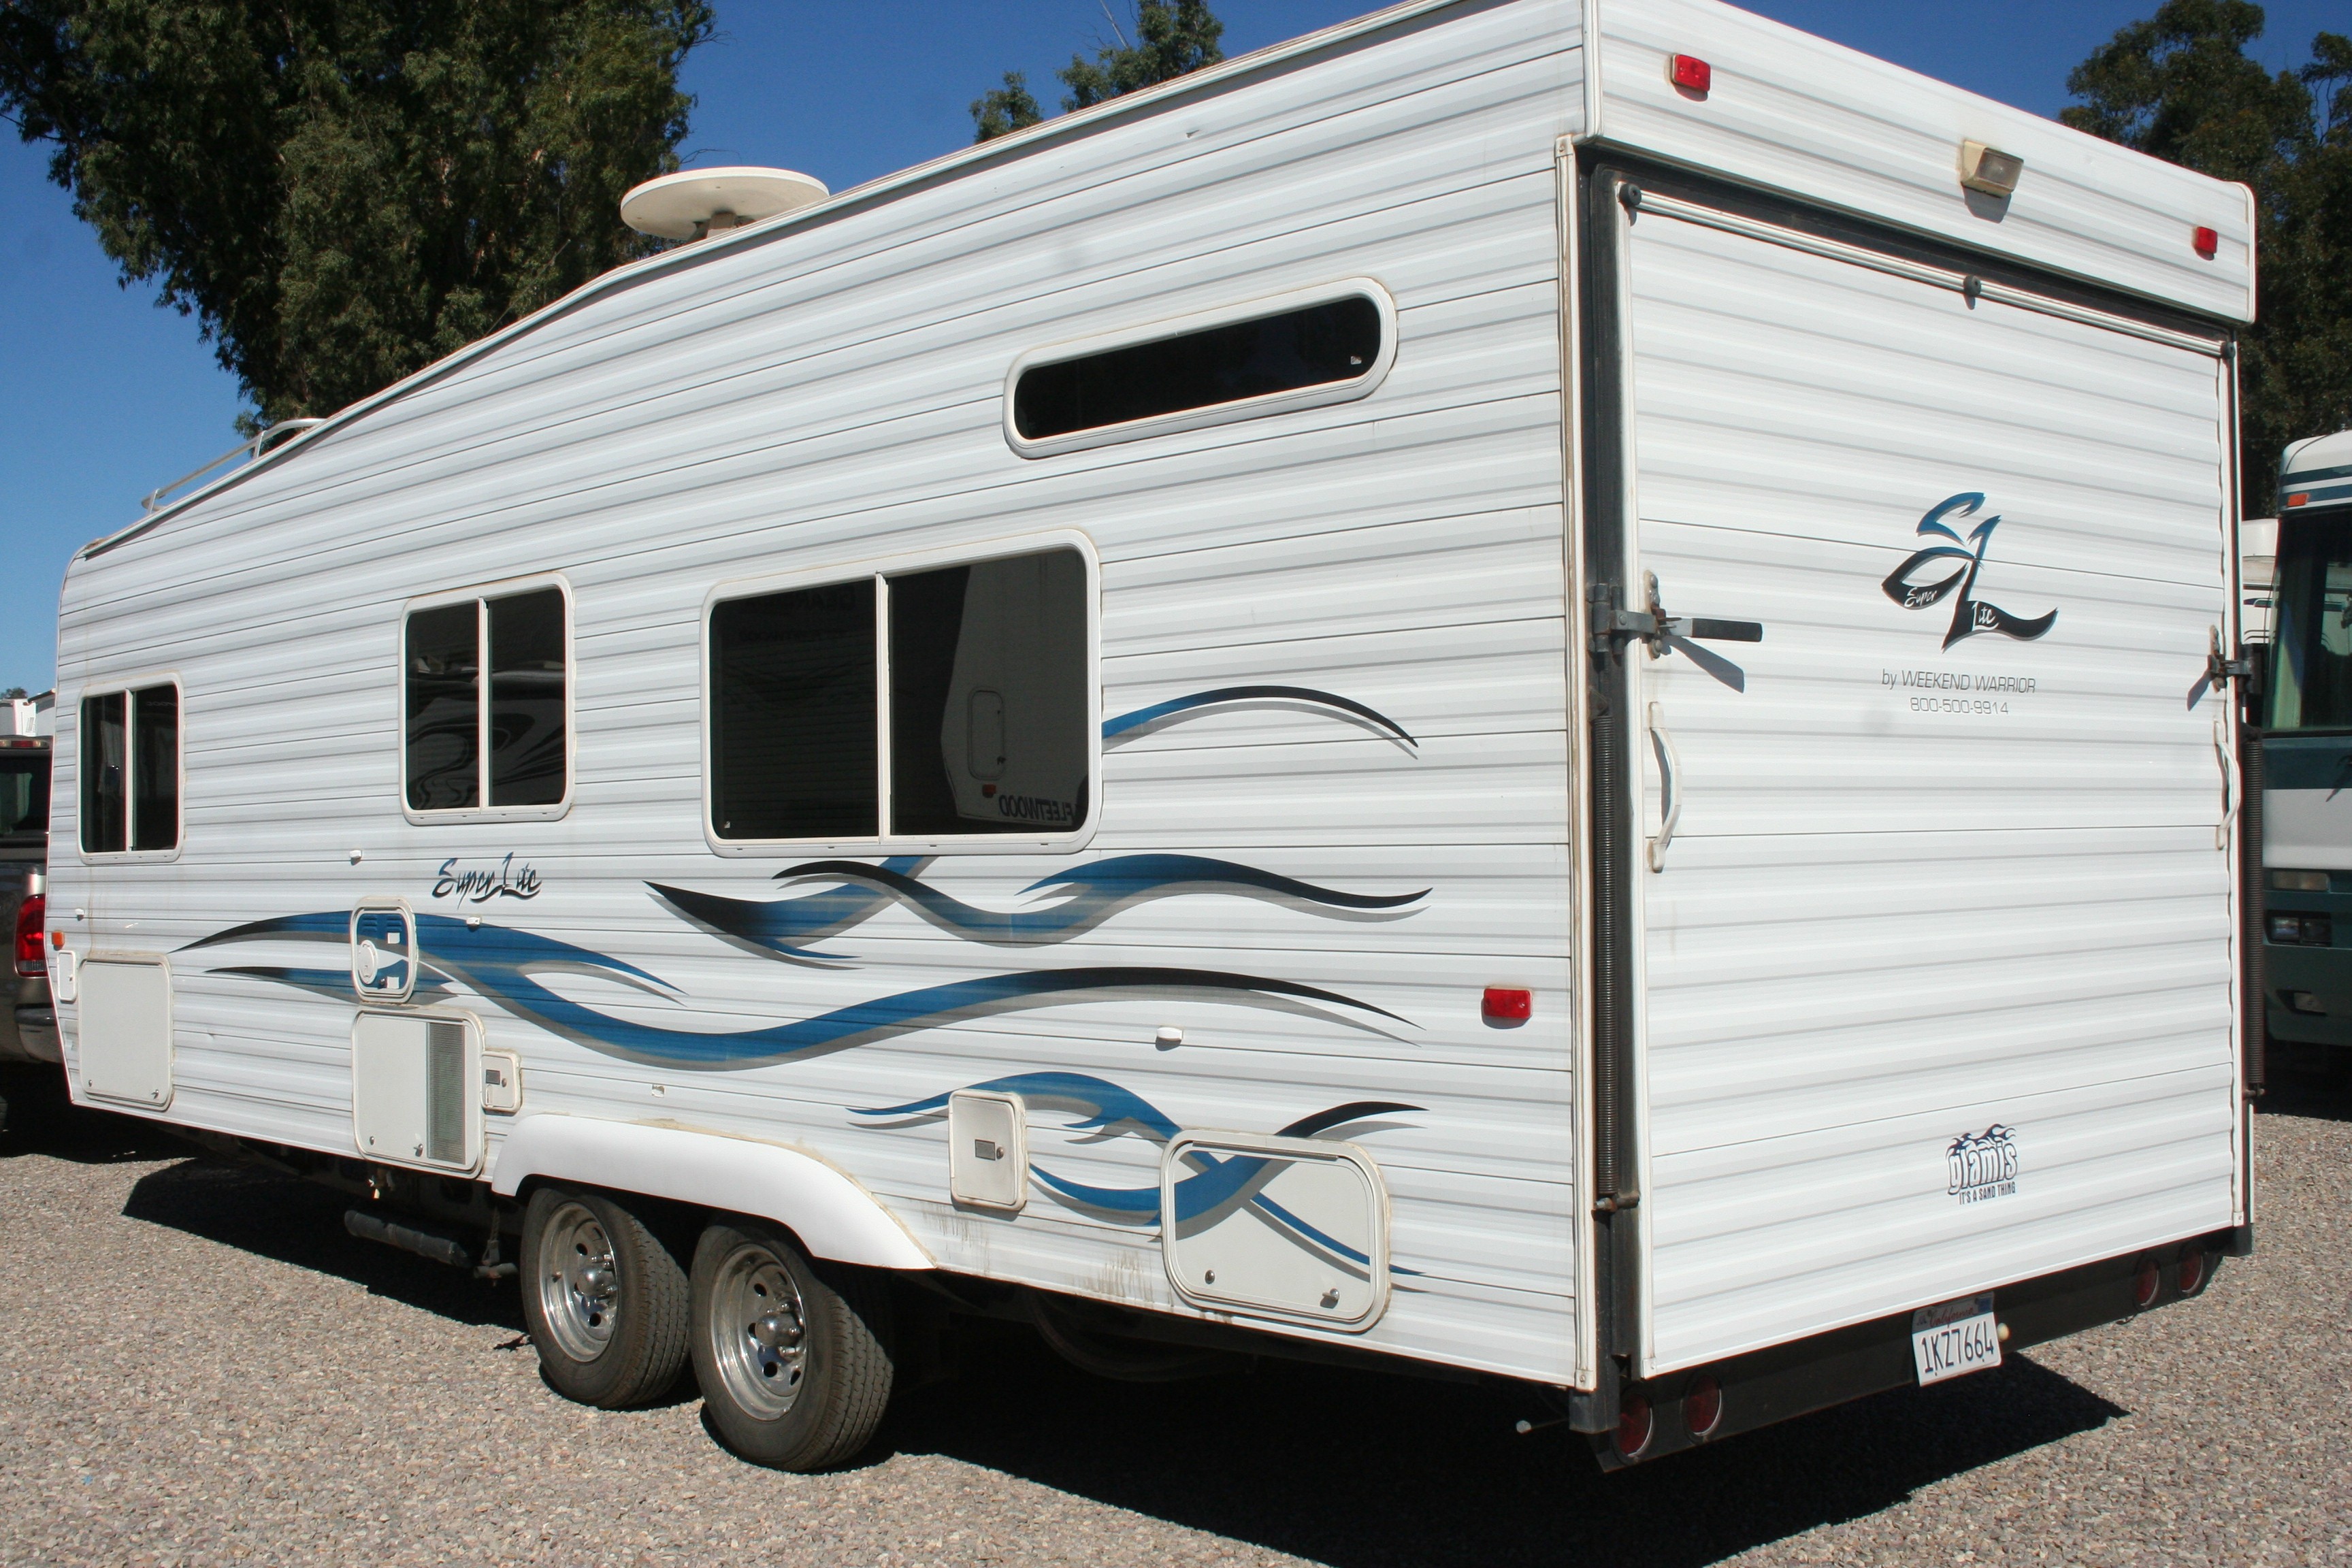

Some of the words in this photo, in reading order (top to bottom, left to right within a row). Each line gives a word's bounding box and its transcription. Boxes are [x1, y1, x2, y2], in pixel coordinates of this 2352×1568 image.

[1882, 668, 1897, 690] by
[1901, 670, 1970, 691] WEEKEND
[1975, 675, 2036, 693] WARRIOR
[1910, 698, 2008, 715] 800-500-9914
[1959, 1190, 1971, 1205] IT'S
[1973, 1190, 1977, 1202] A
[1979, 1186, 1995, 1200] SAND
[1997, 1181, 2016, 1196] THING
[1921, 1321, 1994, 1374] 1KZ7664
